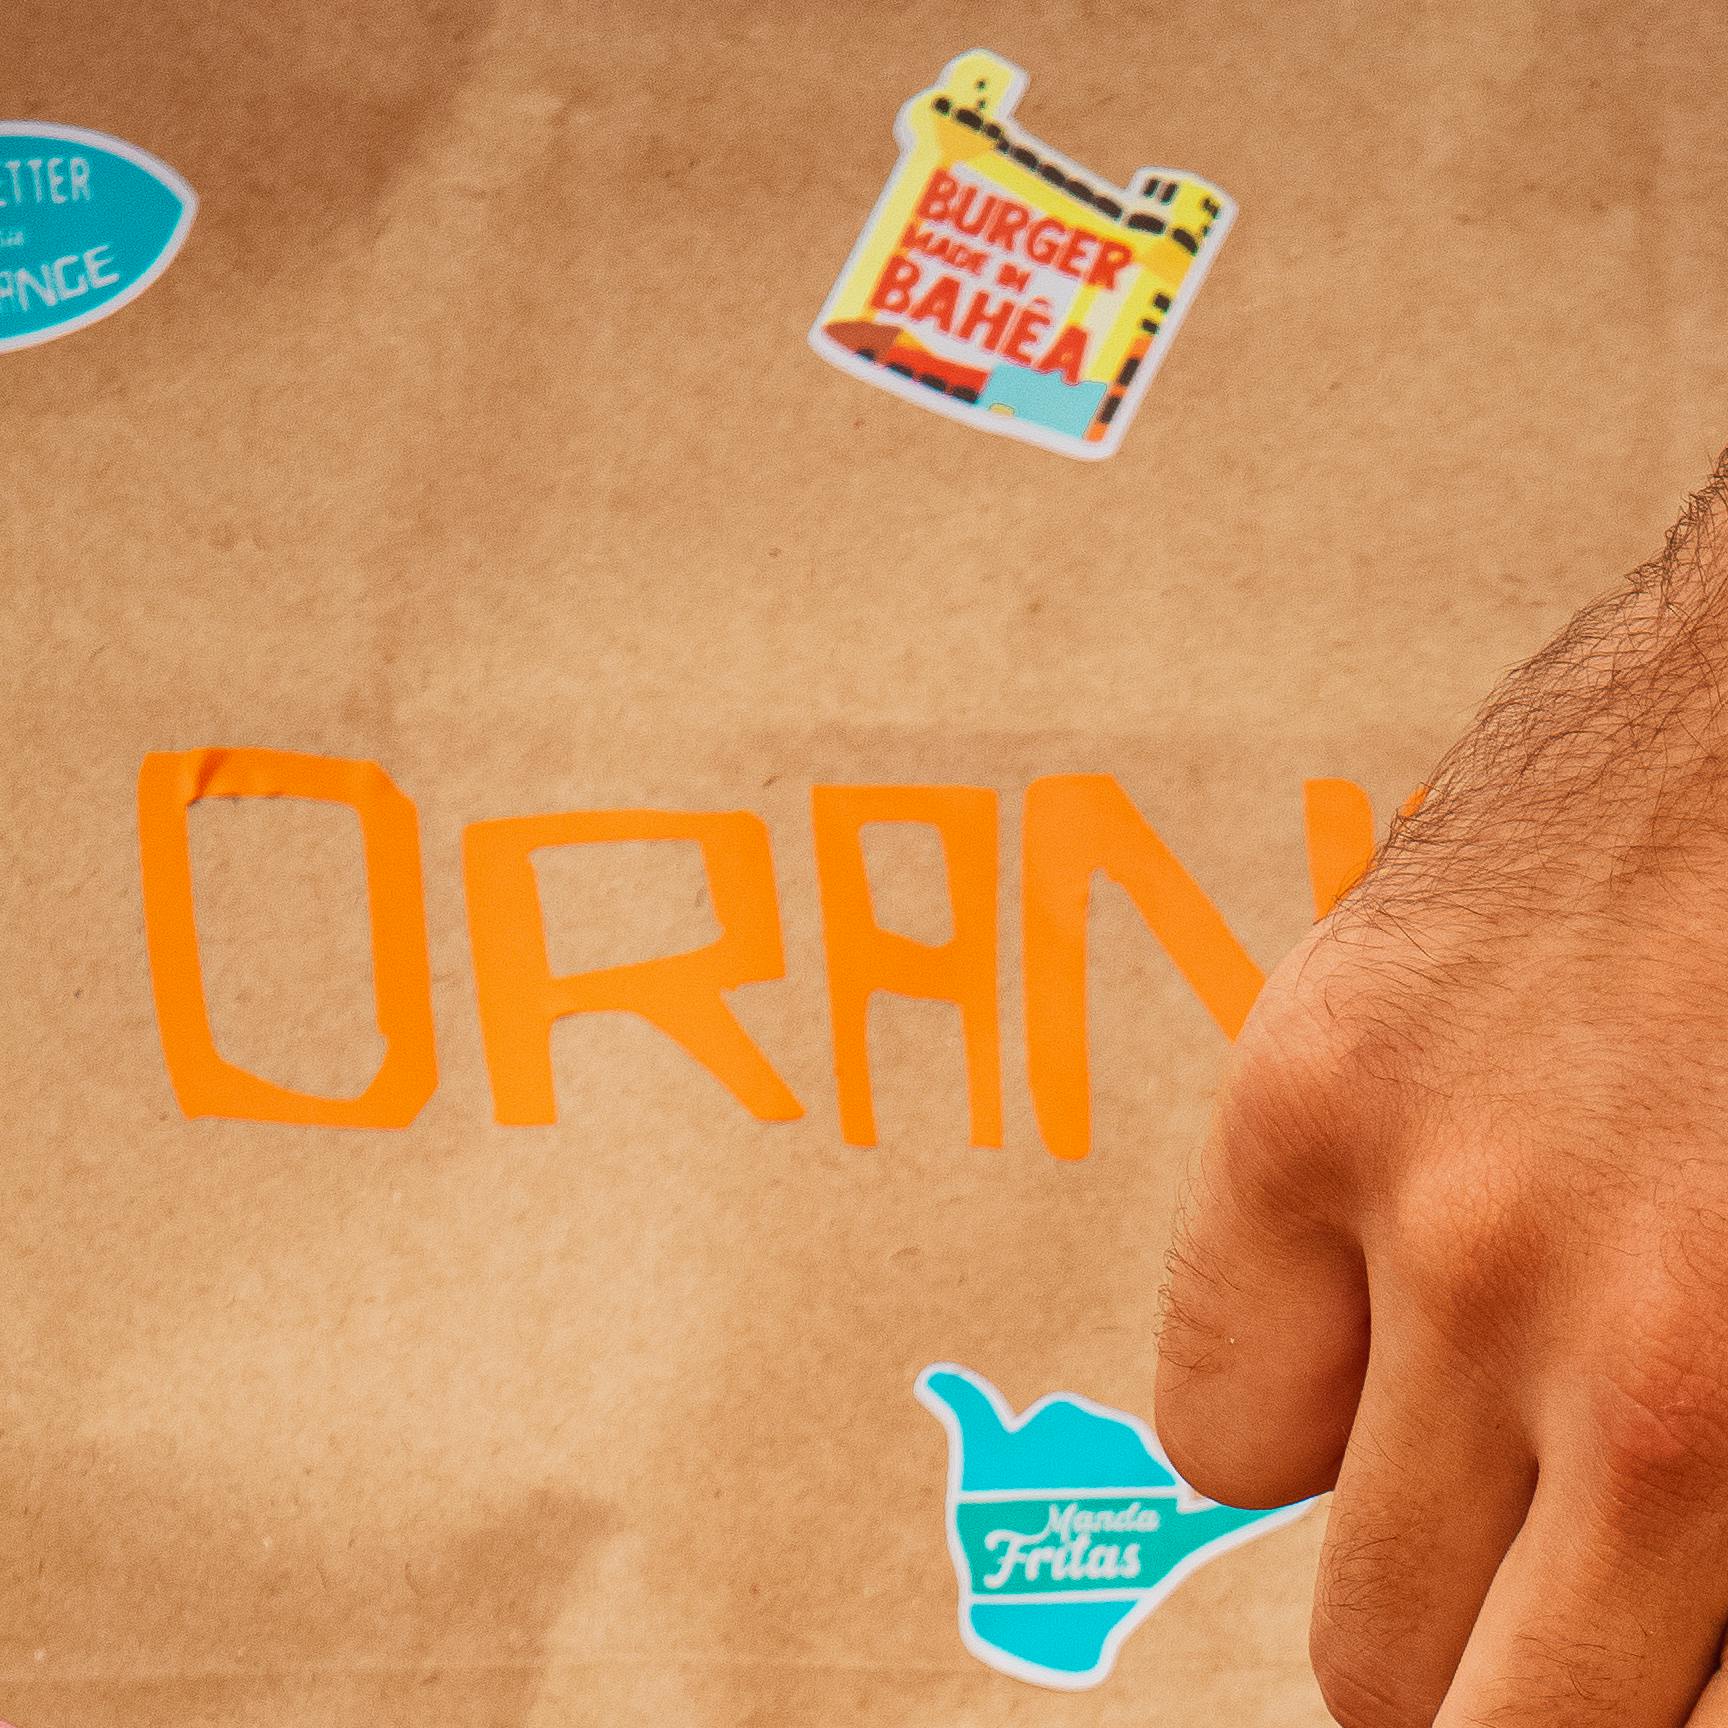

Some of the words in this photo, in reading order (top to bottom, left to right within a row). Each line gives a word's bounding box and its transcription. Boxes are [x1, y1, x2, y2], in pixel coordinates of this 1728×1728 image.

[0, 157, 91, 206] TTER
[916, 167, 1132, 290] BURGER
[137, 746, 1430, 1161] ORAN
[1047, 1502, 1161, 1542] Manda
[983, 1530, 1142, 1589] Fritas
